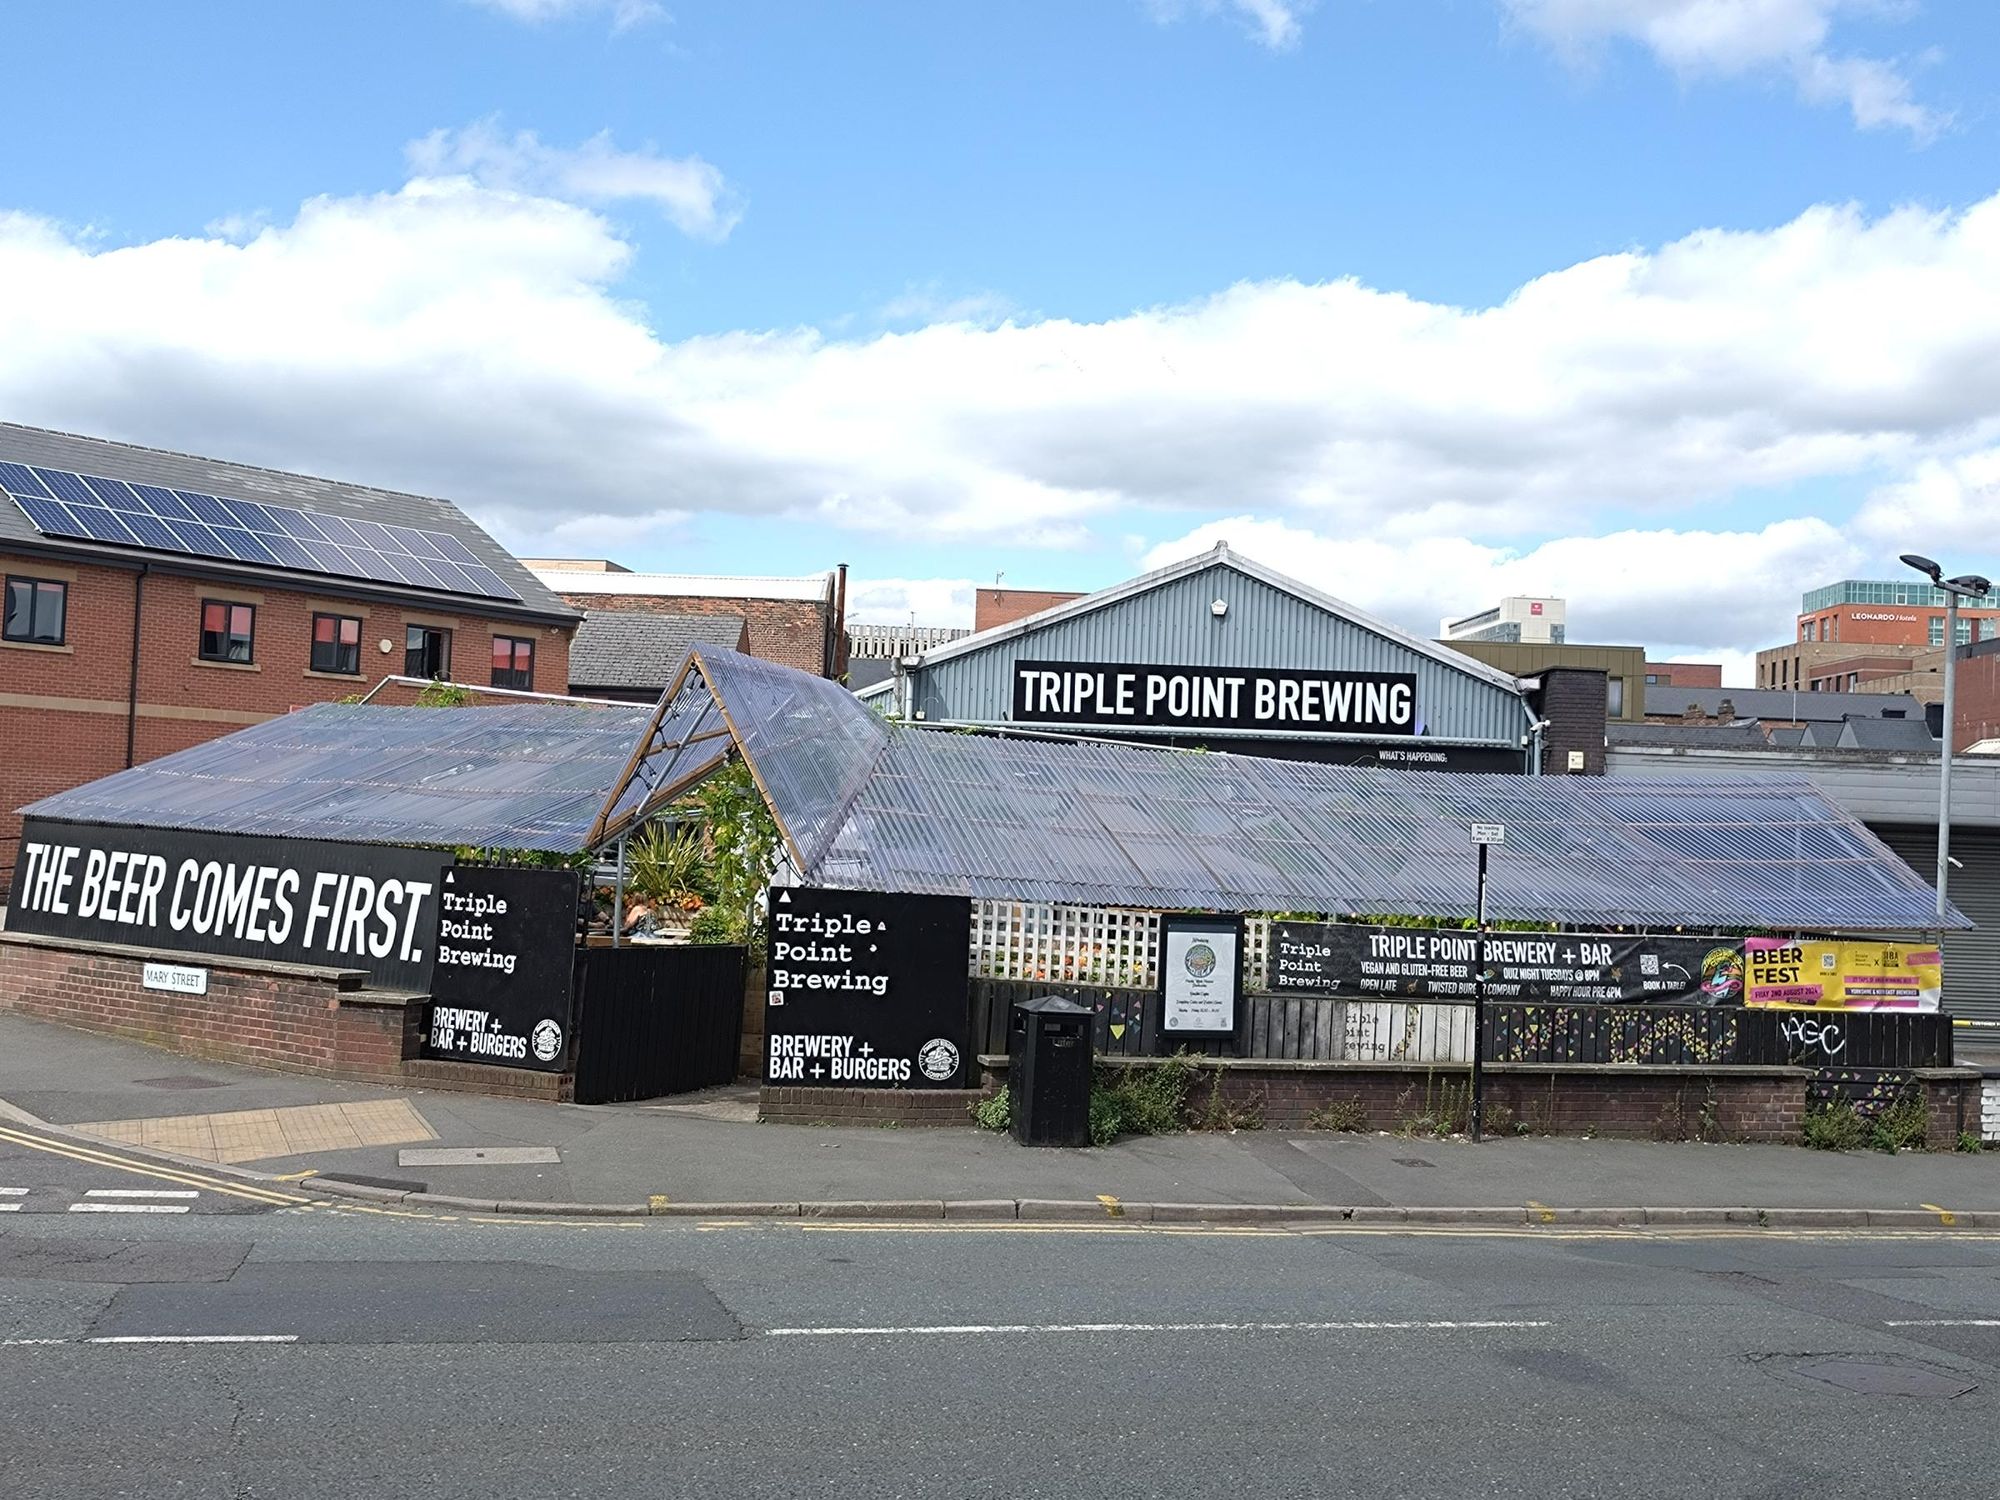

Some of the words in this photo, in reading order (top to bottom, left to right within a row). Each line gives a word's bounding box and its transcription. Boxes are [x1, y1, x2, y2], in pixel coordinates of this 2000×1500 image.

[1851, 613, 1895, 621] LEONARDO
[1019, 669, 1136, 716] TRIPLE
[1144, 674, 1246, 719] POINT
[1254, 678, 1412, 725] BREWING
[1379, 750, 1405, 760] WHAT'S
[21, 842, 81, 915] THE
[78, 849, 168, 928] BEER
[168, 858, 300, 945] COMES
[302, 871, 432, 963] FIRST.
[443, 892, 507, 917] Triple
[440, 919, 493, 941] Point
[776, 912, 871, 938] Triple
[438, 945, 516, 974] Brewing
[774, 941, 852, 962] Point
[1280, 943, 1331, 958] Triple
[1369, 934, 1427, 959] TRIPLE
[1430, 937, 1477, 961] POINT
[1483, 940, 1557, 965] BREWERY
[1581, 943, 1613, 966] BAR
[1752, 947, 1803, 965] BEER
[1278, 960, 1322, 973] Point
[1361, 961, 1384, 975] VEGAN
[1385, 962, 1400, 975] AND
[1401, 962, 1449, 977] GLUTEN-FREE
[1449, 964, 1468, 978] BEER
[1503, 969, 1519, 981] QUIZ
[1519, 969, 1540, 981] NIGHT
[1540, 969, 1574, 982] TUESDAYS
[1753, 967, 1800, 984] FEST
[146, 970, 169, 983] MARY
[172, 972, 200, 987] STREET
[773, 969, 888, 995] Brewing
[1278, 975, 1341, 990] Brewing
[1360, 978, 1379, 991] OPEN
[1380, 979, 1397, 992] LATE
[1428, 981, 1457, 994] TWISTED
[1458, 982, 1487, 995] BURGR
[1487, 984, 1521, 997] COMPANY
[1550, 985, 1573, 998] HAPPY
[1573, 985, 1592, 999] HOUR
[1592, 985, 1606, 999] PRE
[1643, 981, 1661, 990] BOOK
[1783, 987, 1804, 997] AUGUST
[433, 1006, 489, 1032] BREWERY
[430, 1028, 456, 1050] BAR
[470, 1032, 527, 1059] BURGERS
[770, 1034, 853, 1058] BREWERY
[769, 1056, 804, 1079] BAR
[831, 1058, 911, 1081] BURGERS
